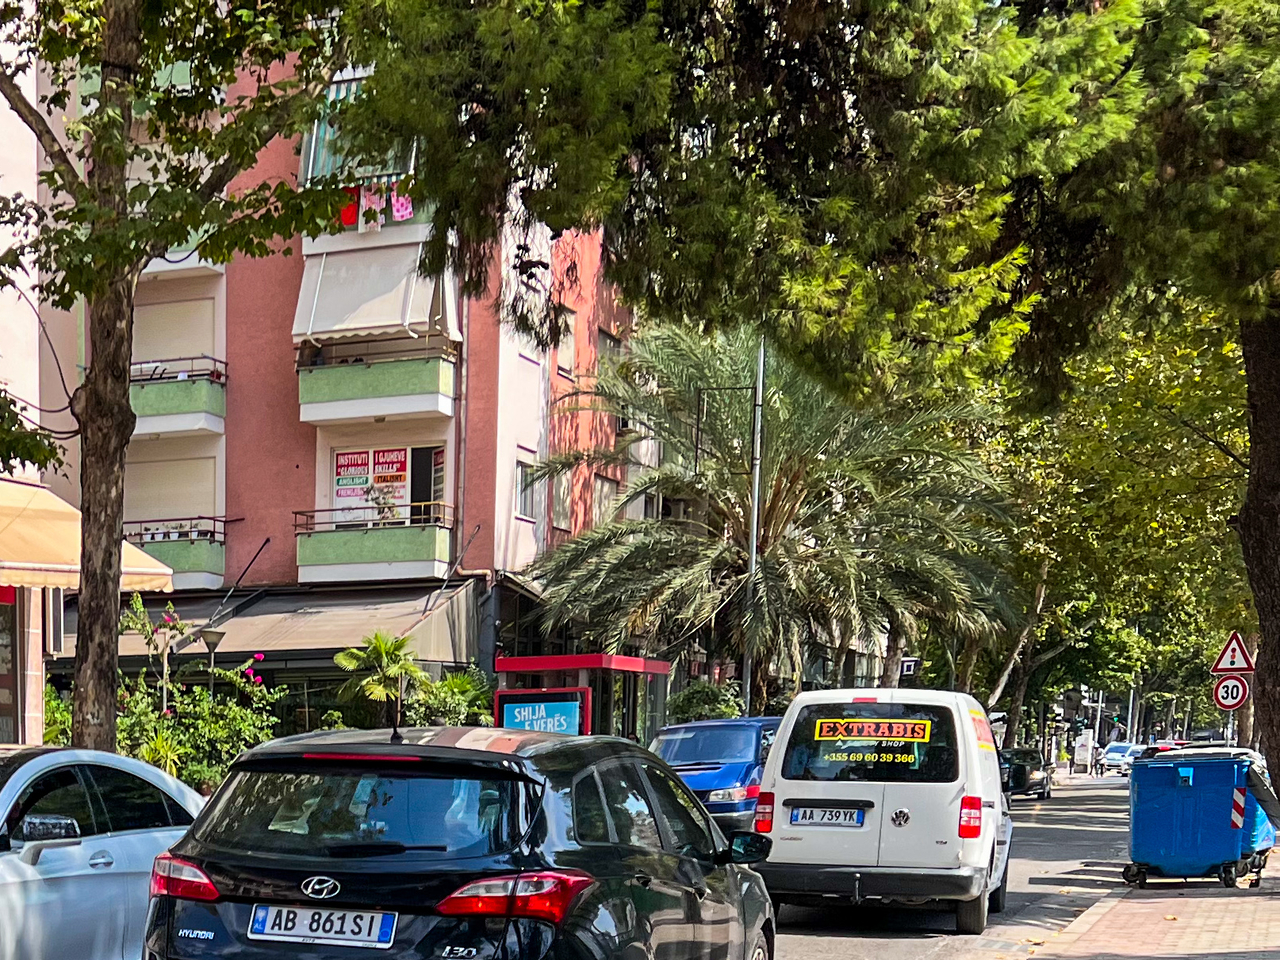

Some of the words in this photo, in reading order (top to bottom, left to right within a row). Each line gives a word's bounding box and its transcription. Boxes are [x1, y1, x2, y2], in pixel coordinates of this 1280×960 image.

[337, 453, 368, 466] INSTITUTI
[1221, 685, 1240, 700] 30
[514, 704, 546, 722] SHIJA
[820, 722, 925, 738] EXTRABIS
[824, 753, 848, 762] +355
[849, 753, 863, 762] 69
[864, 753, 878, 762] 60
[880, 753, 893, 763] 39
[801, 810, 814, 821] AA
[820, 810, 839, 822] 739
[842, 810, 856, 822] YK
[271, 909, 297, 932] AB
[178, 929, 215, 940] HYUNDAI
